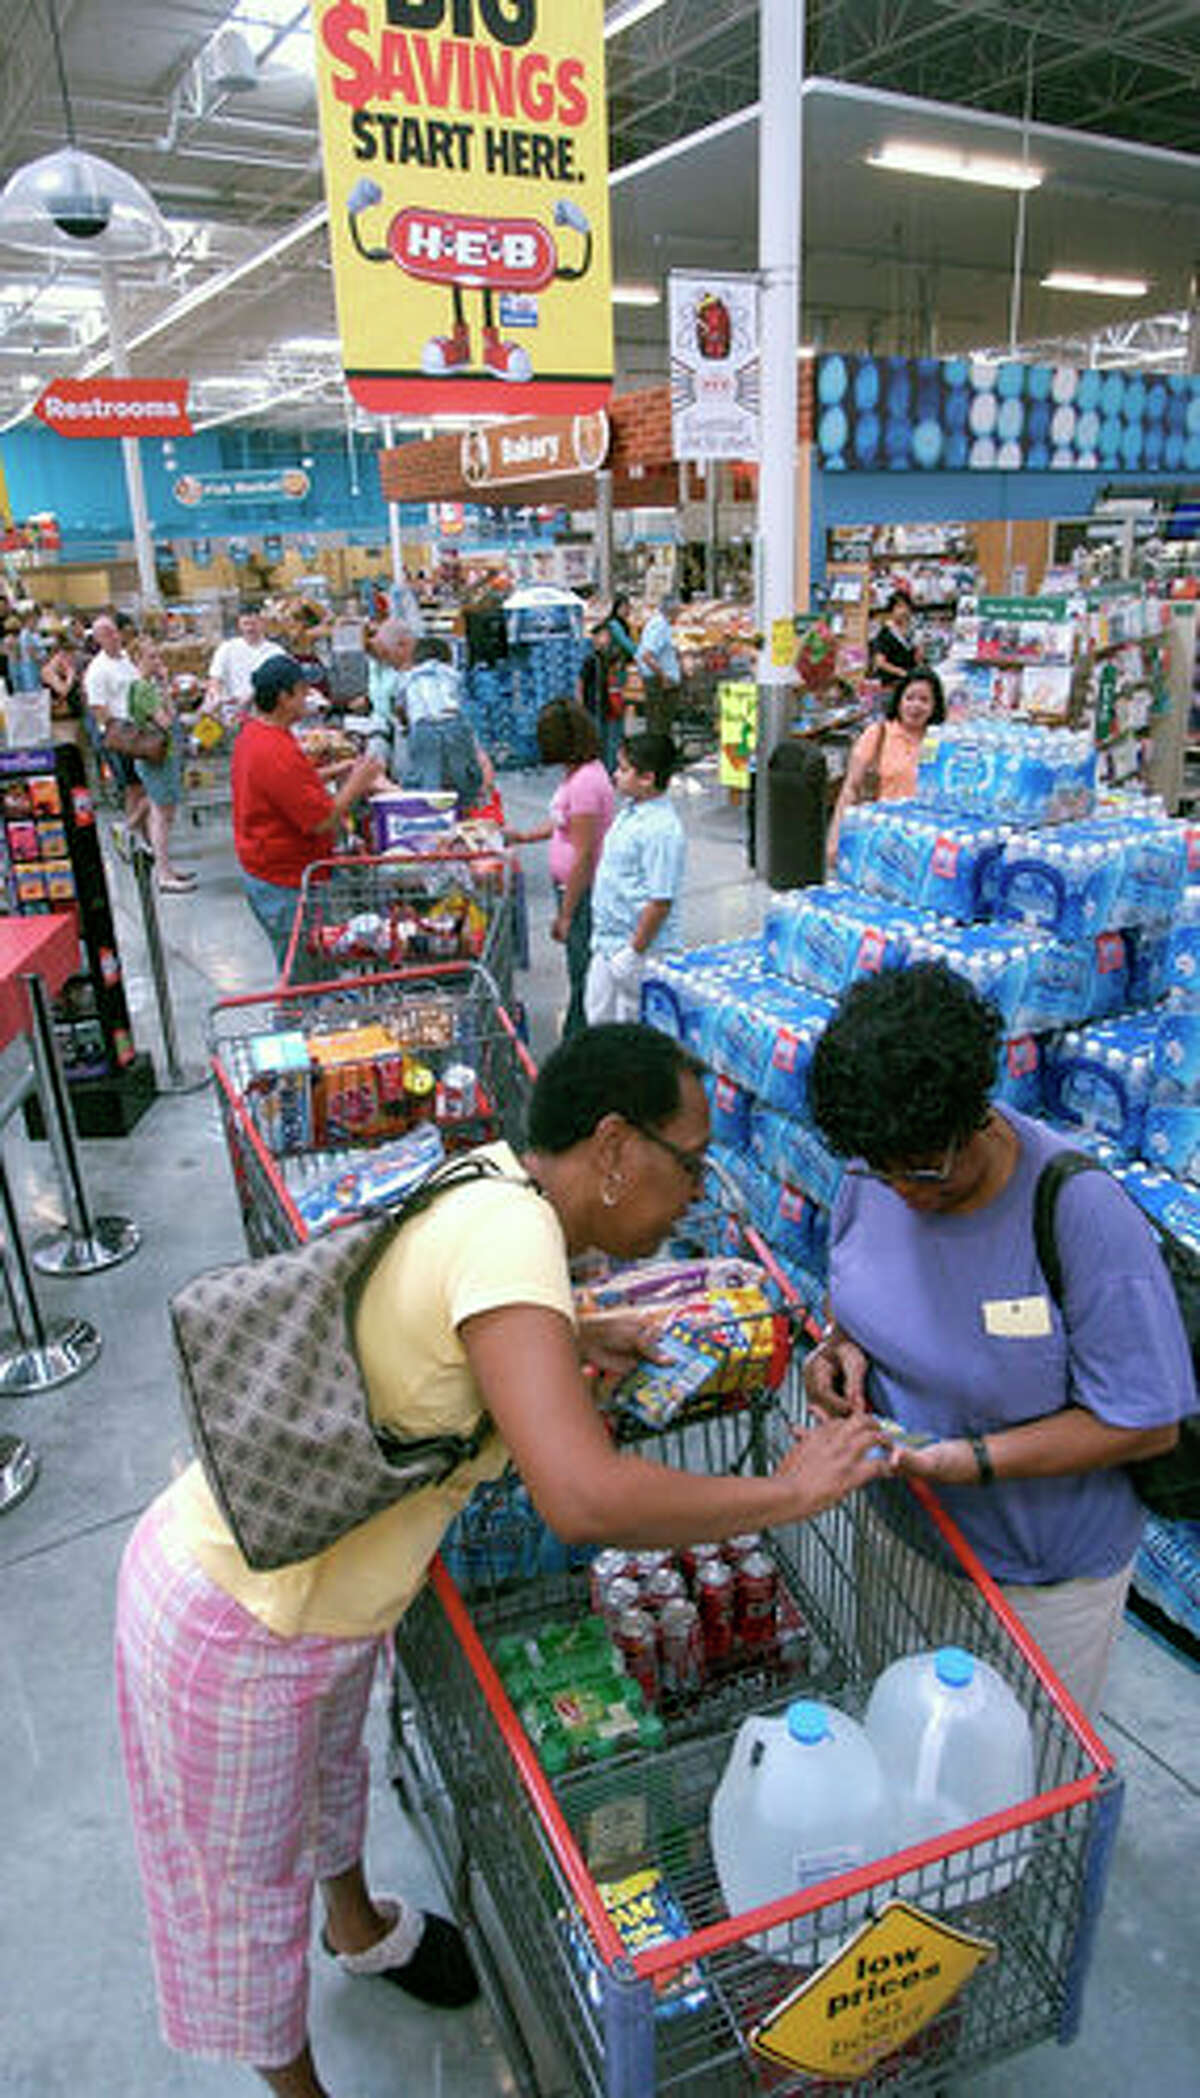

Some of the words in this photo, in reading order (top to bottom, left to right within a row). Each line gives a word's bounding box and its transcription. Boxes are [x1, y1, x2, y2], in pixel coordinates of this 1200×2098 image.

[352, 110, 474, 172] START
[485, 127, 585, 183] HERE.
[46, 396, 182, 420] Restrooms
[857, 1946, 923, 1980] low
[827, 1962, 941, 2018] prices
